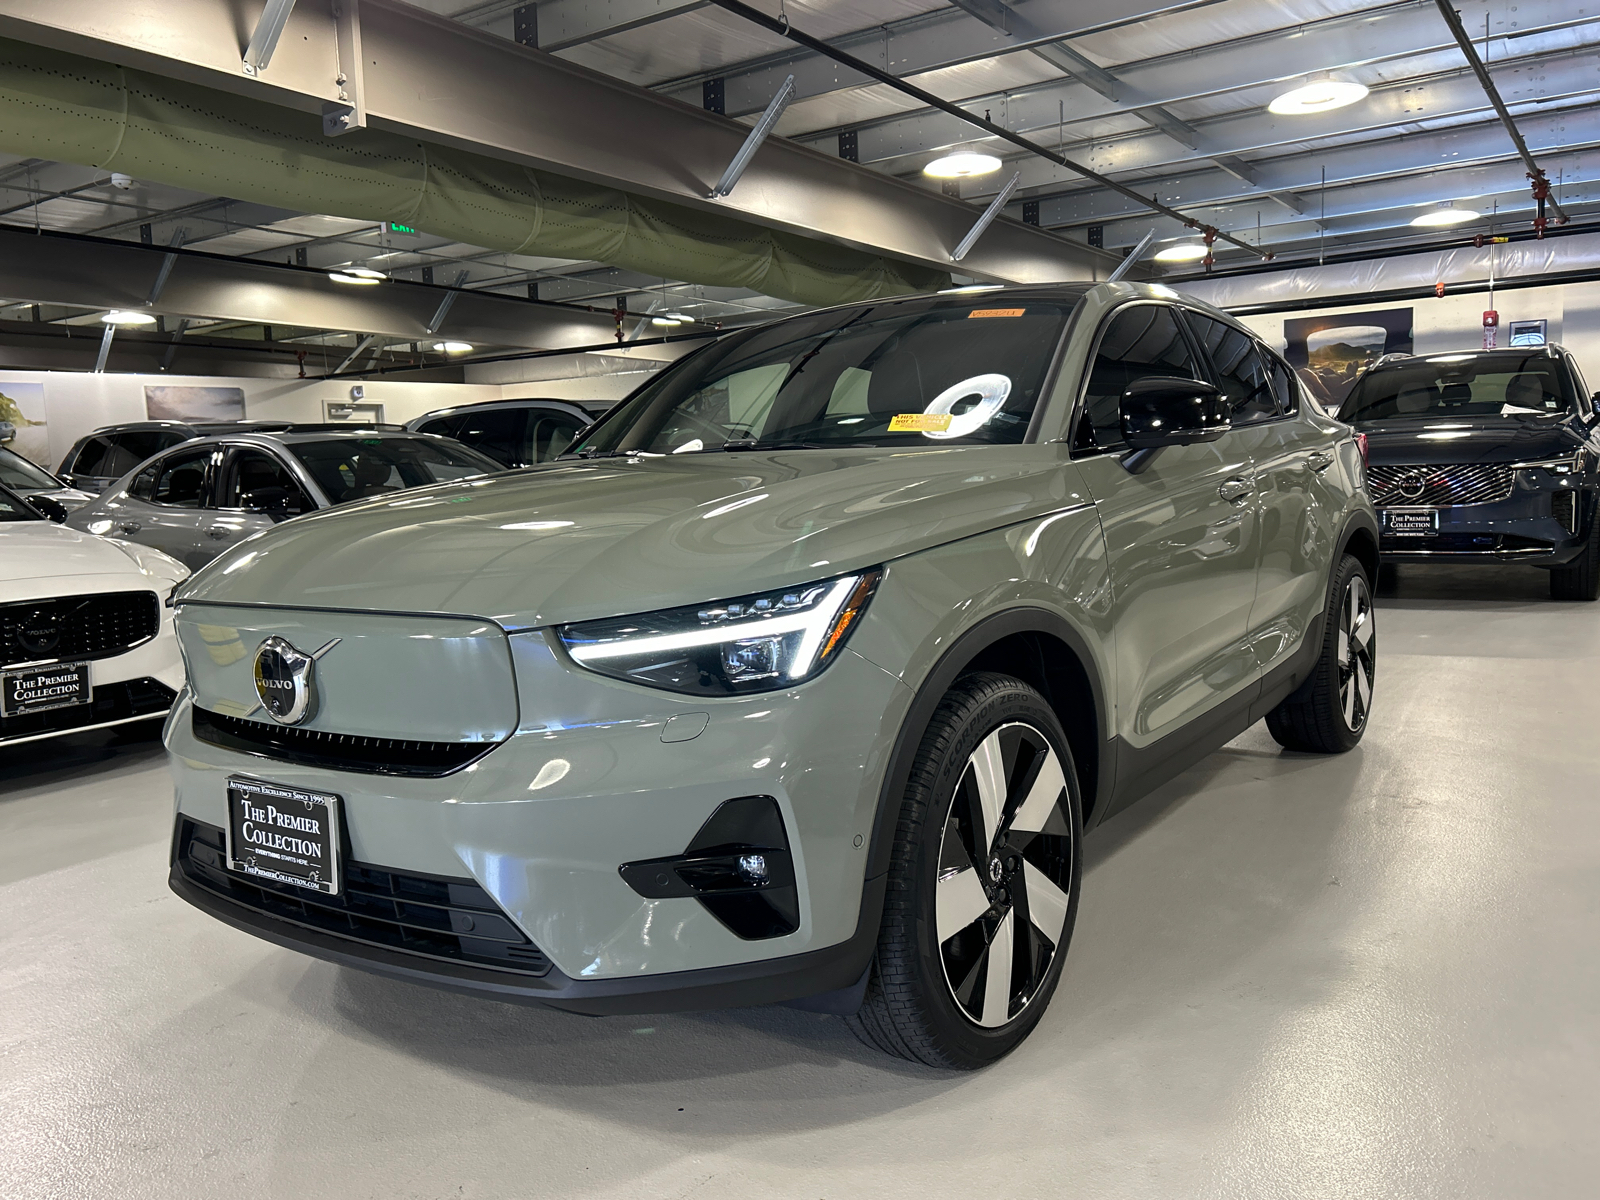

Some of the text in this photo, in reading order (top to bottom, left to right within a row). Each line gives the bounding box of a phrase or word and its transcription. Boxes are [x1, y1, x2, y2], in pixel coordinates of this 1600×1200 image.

[13, 673, 79, 690] THE PREMIER
[13, 683, 80, 701] COLLECTION
[255, 677, 293, 690] VOLVO
[943, 693, 1028, 782] SCORPION ZERO
[230, 781, 325, 805] AUTOMOTIVE EXCELLENCE SINCE 1995
[241, 799, 321, 835] THE PREMIER
[242, 821, 322, 859] COLLECTION
[255, 847, 280, 860] EVERYTHING
